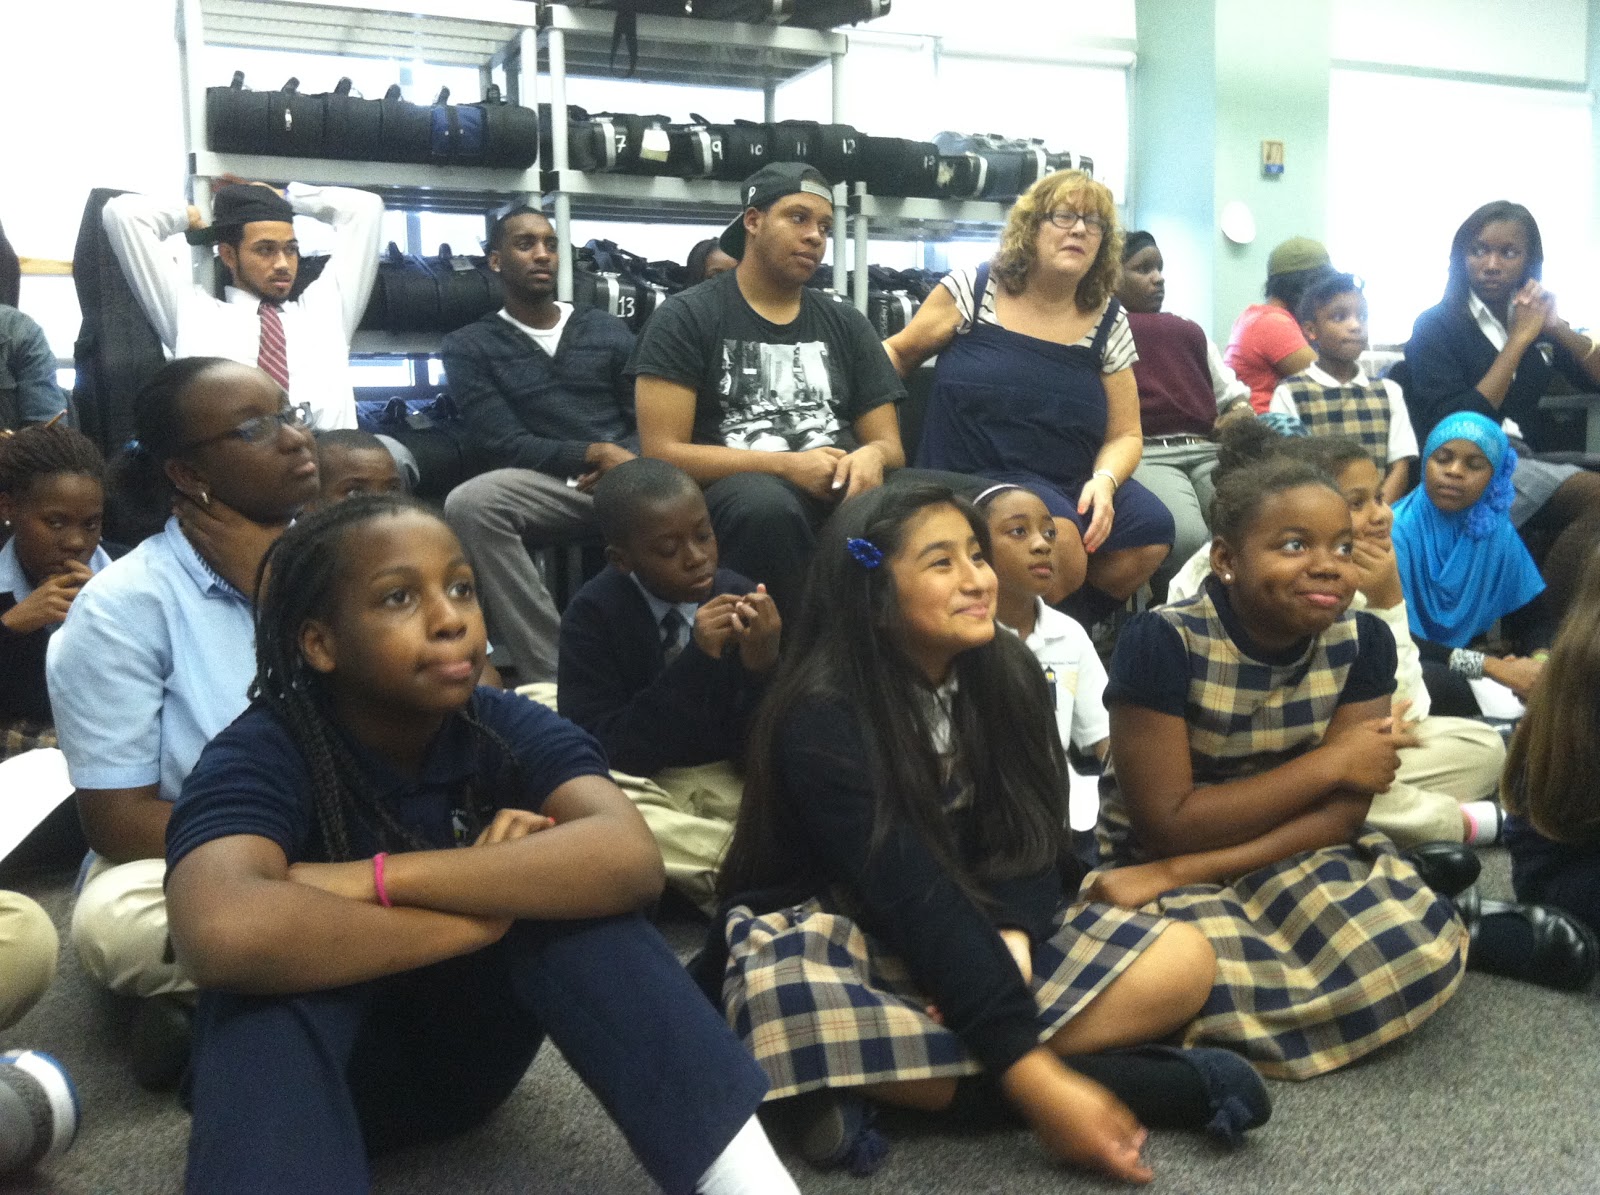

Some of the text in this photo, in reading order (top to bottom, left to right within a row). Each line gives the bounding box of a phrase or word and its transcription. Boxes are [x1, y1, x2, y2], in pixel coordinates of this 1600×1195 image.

[615, 134, 627, 154] 7
[711, 140, 723, 160] 9
[750, 143, 763, 156] 10
[796, 141, 807, 156] 11
[617, 295, 636, 318] 13
